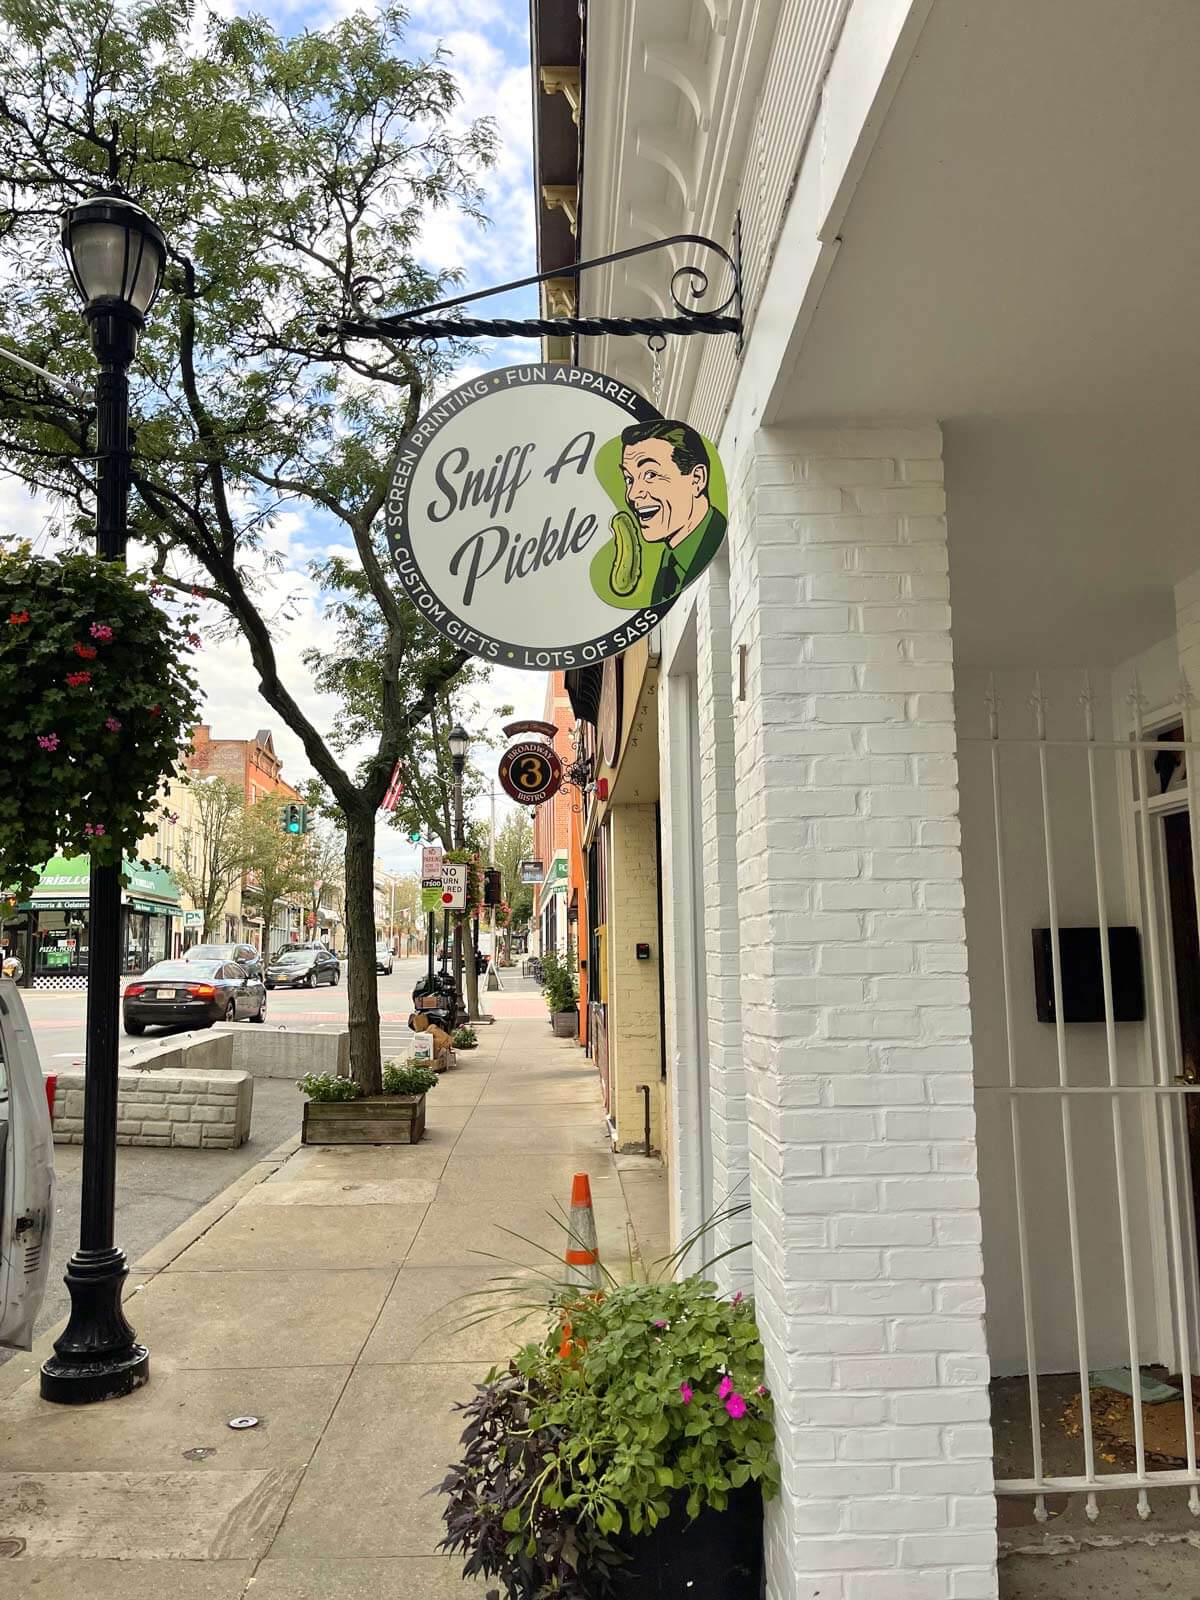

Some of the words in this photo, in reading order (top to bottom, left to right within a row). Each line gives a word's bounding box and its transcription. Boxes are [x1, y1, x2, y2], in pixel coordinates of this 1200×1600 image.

[505, 367, 547, 385] FUN
[553, 367, 641, 411] APPAREL
[388, 450, 418, 527] SCREEN
[411, 380, 490, 448] PRINTING
[427, 442, 537, 523] Sniff
[543, 431, 596, 484] A
[449, 507, 599, 607] Pickle
[394, 547, 447, 622] CUSTOM
[446, 620, 501, 658] GIFTS
[524, 650, 576, 667] LOTS
[582, 640, 609, 661] OF
[613, 609, 659, 648] SASS
[508, 743, 554, 761] BROADWAY
[520, 757, 543, 788] 3
[517, 791, 547, 802] BISTRO
[442, 867, 457, 877] NO
